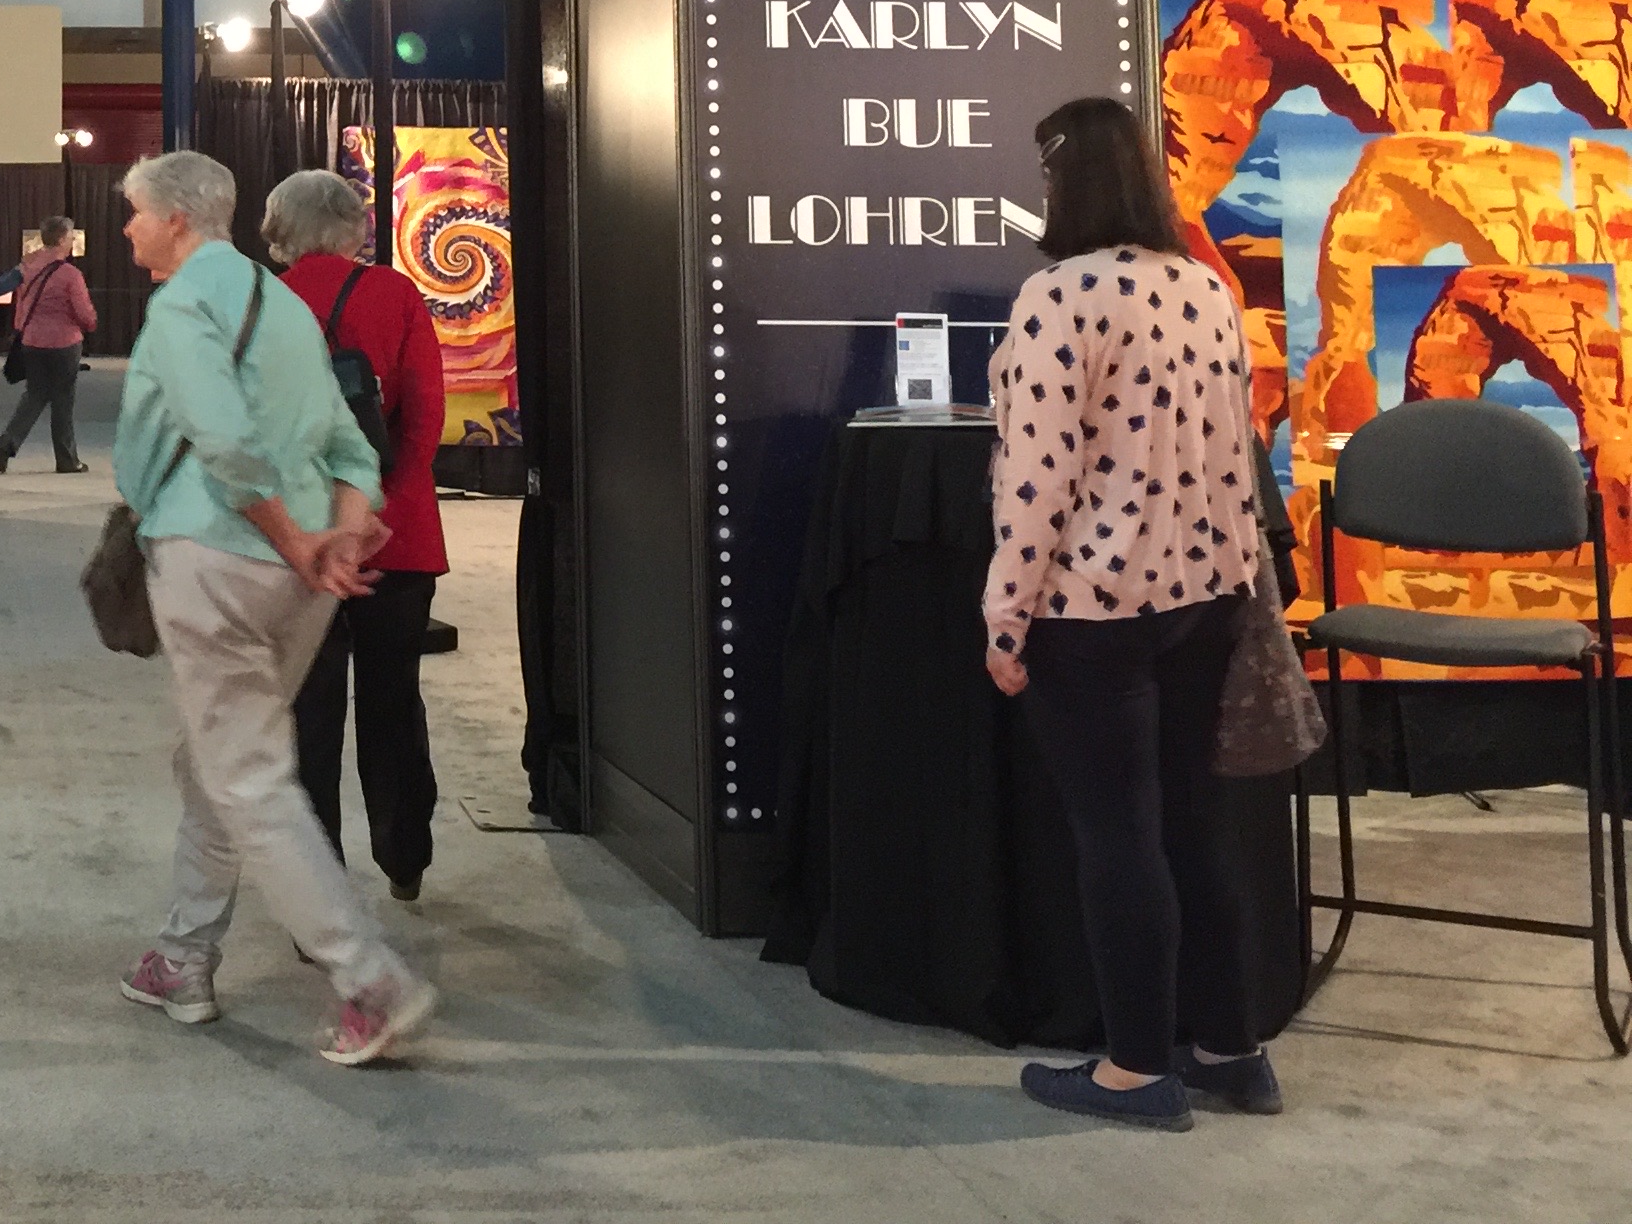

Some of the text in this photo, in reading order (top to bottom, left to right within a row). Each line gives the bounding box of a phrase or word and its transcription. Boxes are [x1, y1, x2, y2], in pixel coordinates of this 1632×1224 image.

[765, 0, 1063, 52] KARLYN
[843, 98, 993, 148] BUE
[748, 195, 1048, 246] LOHREN
